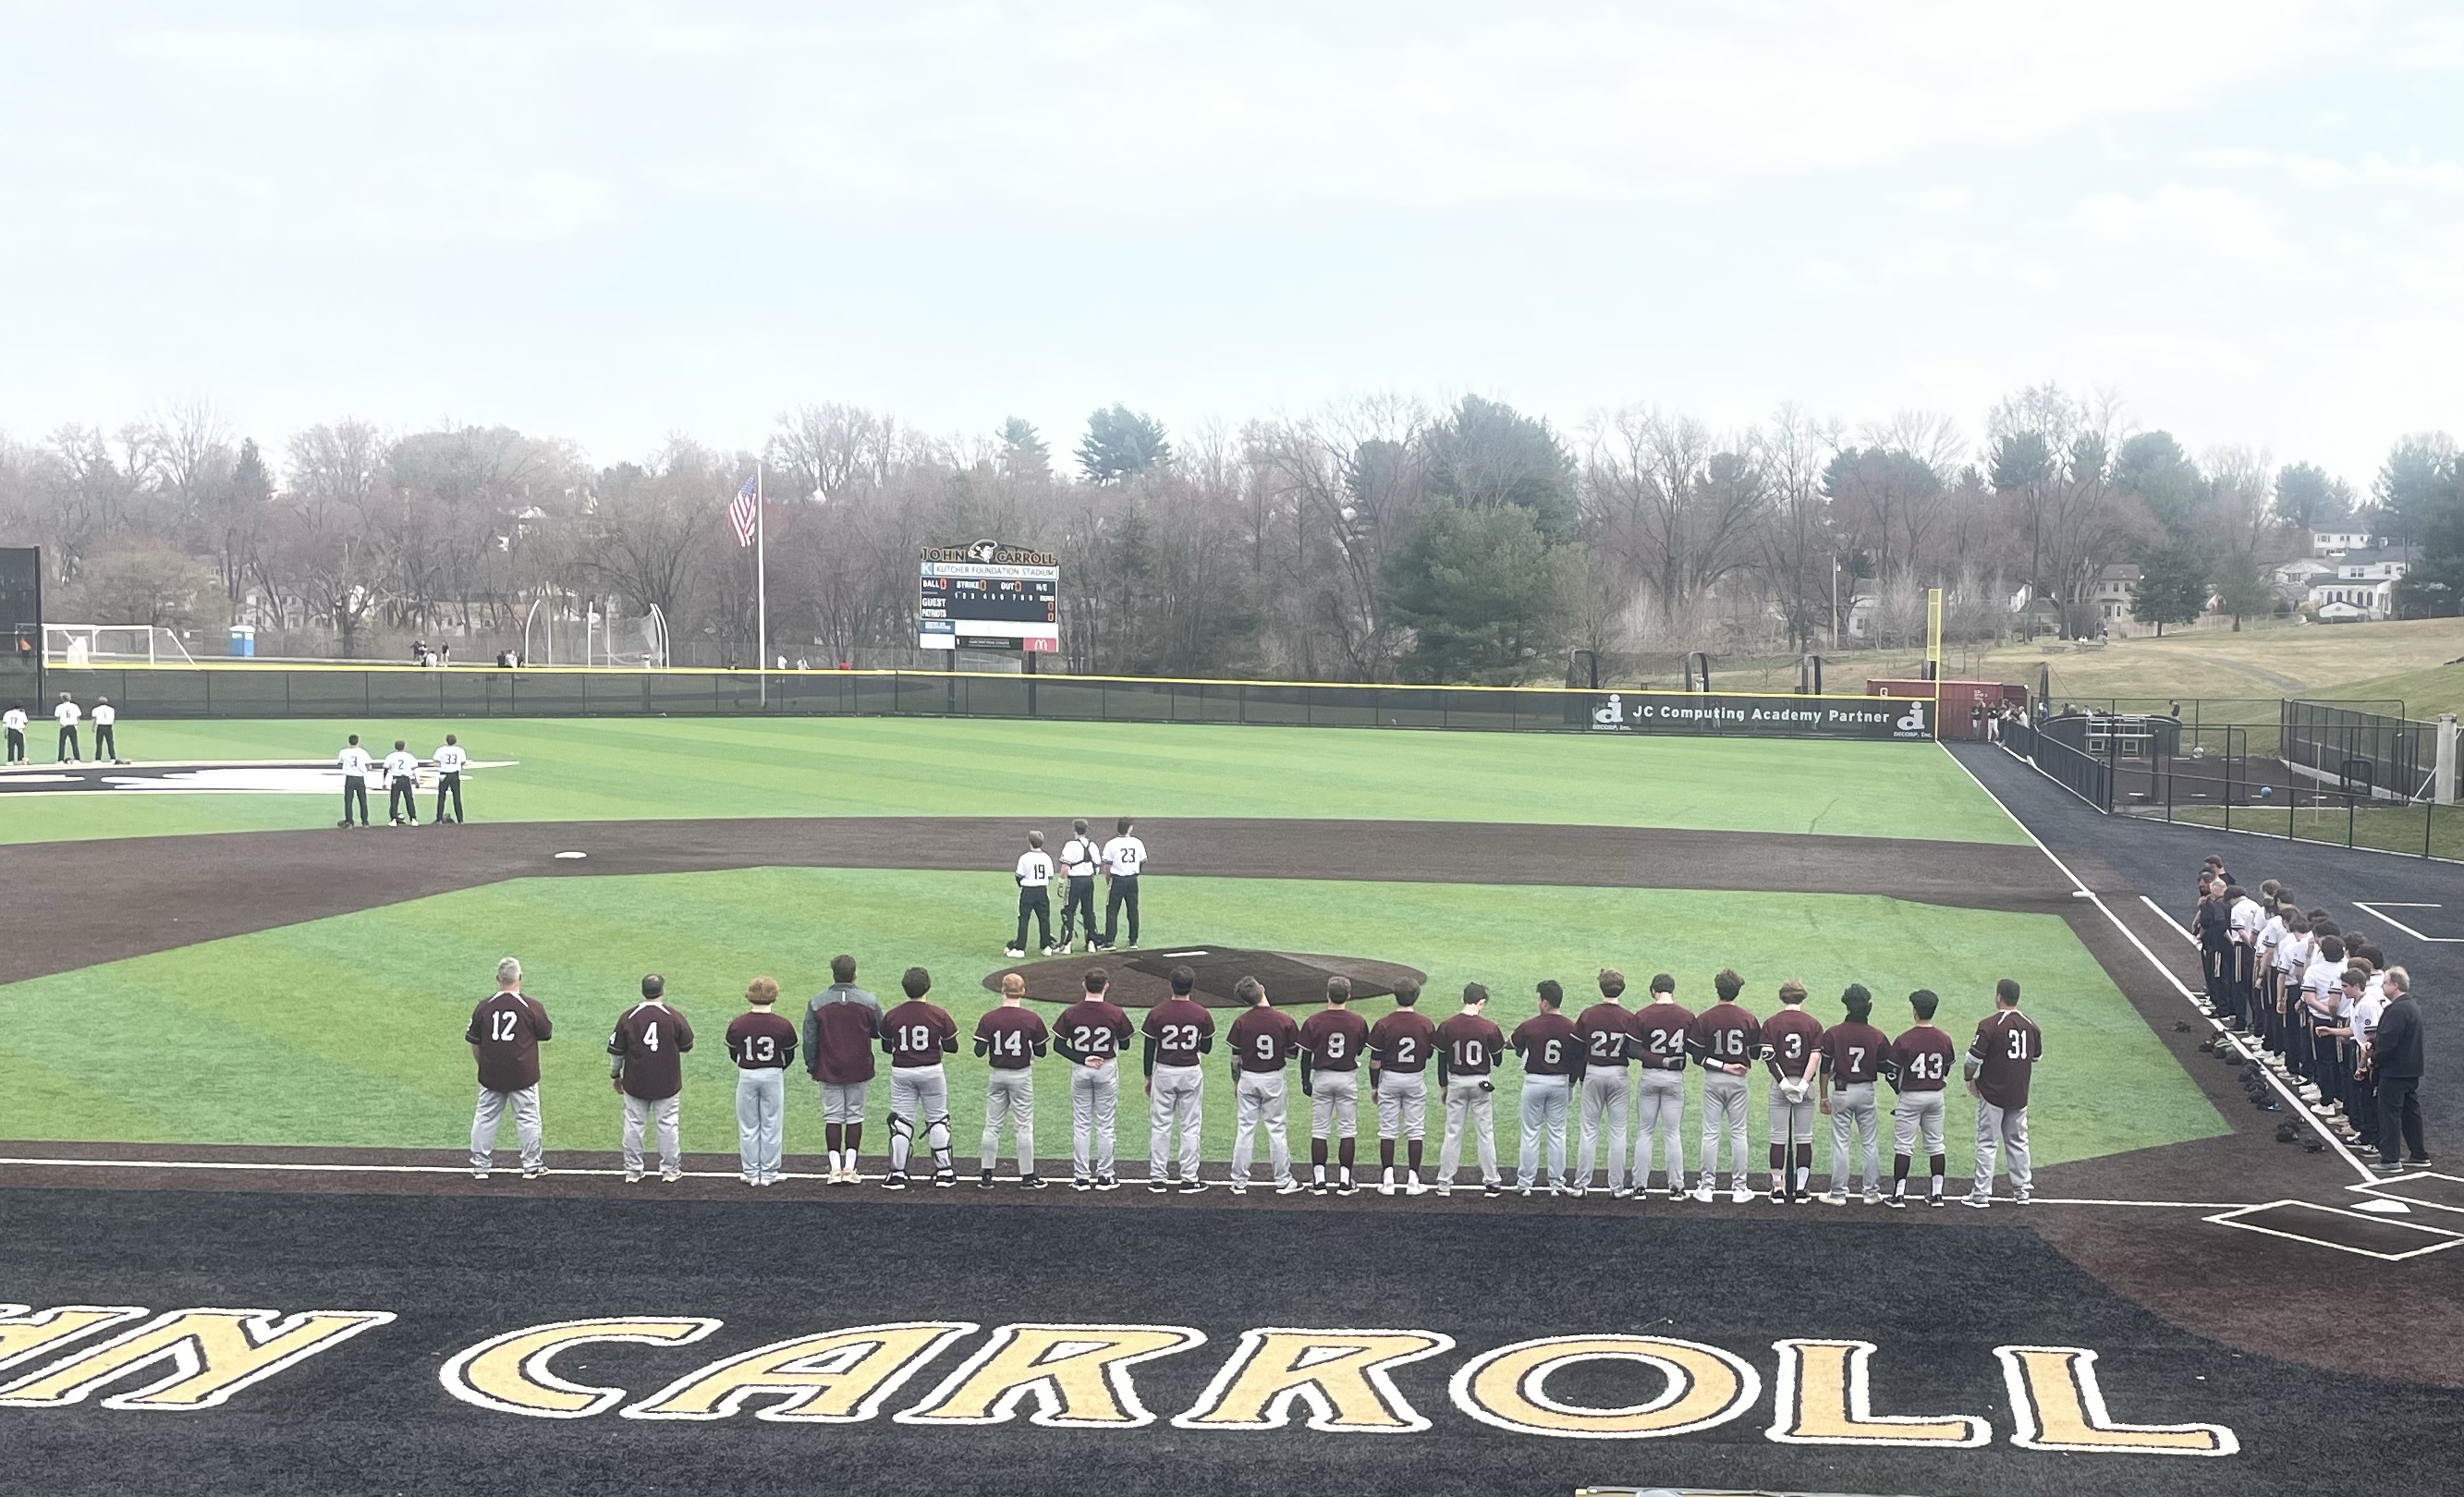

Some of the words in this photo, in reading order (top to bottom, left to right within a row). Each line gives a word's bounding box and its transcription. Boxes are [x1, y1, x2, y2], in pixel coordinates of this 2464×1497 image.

[921, 547, 966, 562] JOHN
[995, 551, 1056, 565] CARROLL
[922, 579, 939, 589] BALL
[936, 565, 970, 574] KUTCHER
[971, 566, 1019, 576] FOUNDATION
[1021, 567, 1055, 577] STADIUM
[1000, 581, 1015, 590] OUT
[921, 597, 946, 608] GUEST
[1632, 705, 1654, 718] JC
[1660, 706, 1745, 723] Computing
[1751, 708, 1823, 724] Academy
[1829, 709, 1890, 723] Partner
[397, 759, 405, 770] 2
[445, 753, 457, 764] 33
[1120, 847, 1136, 863] 23
[1033, 863, 1045, 880] 19
[492, 1010, 518, 1041] 12
[642, 1021, 659, 1052] 4
[898, 1025, 929, 1052] 18
[1161, 1024, 1199, 1051] 23
[743, 1035, 775, 1062] 13
[993, 1029, 1022, 1056] 14
[1073, 1026, 1112, 1053] 22
[1256, 1034, 1275, 1060] 9
[1397, 1037, 1416, 1063] 2
[1544, 1039, 1562, 1065] 6
[1591, 1030, 1625, 1057] 27
[1650, 1028, 1685, 1054] 24
[1714, 1028, 1744, 1055] 16
[1785, 1033, 1802, 1059] 3
[2007, 1028, 2028, 1060] 31
[1452, 1040, 1482, 1066] 10
[1848, 1046, 1865, 1073] 7
[1909, 1053, 1944, 1079] 43
[438, 1316, 2240, 1456] CARROLL
